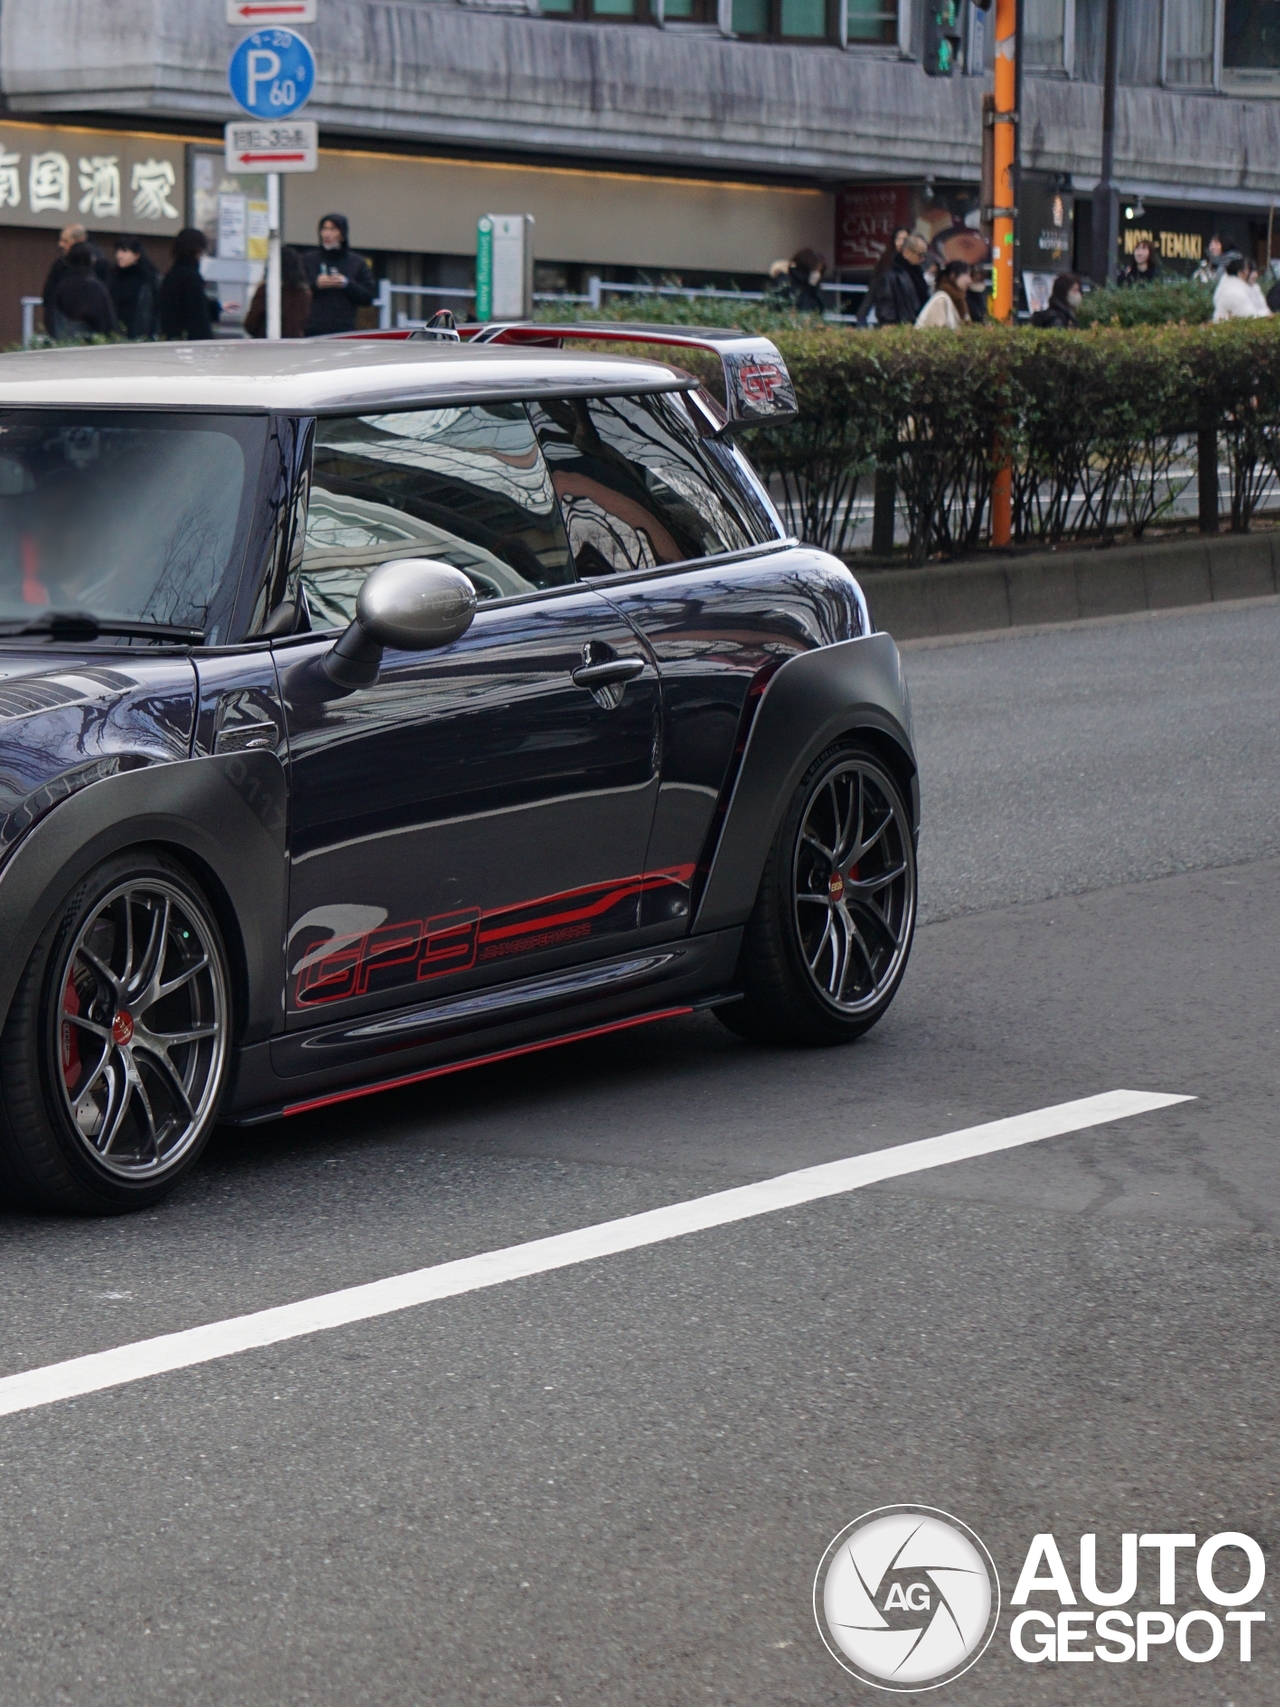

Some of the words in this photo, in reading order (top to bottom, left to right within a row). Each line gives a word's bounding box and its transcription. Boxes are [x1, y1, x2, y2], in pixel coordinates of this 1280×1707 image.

[247, 49, 281, 106] P
[270, 79, 296, 106] 60
[738, 363, 784, 402] GP
[479, 942, 511, 961] JOHN
[510, 932, 556, 953] COOPER
[554, 922, 592, 943] WORKS
